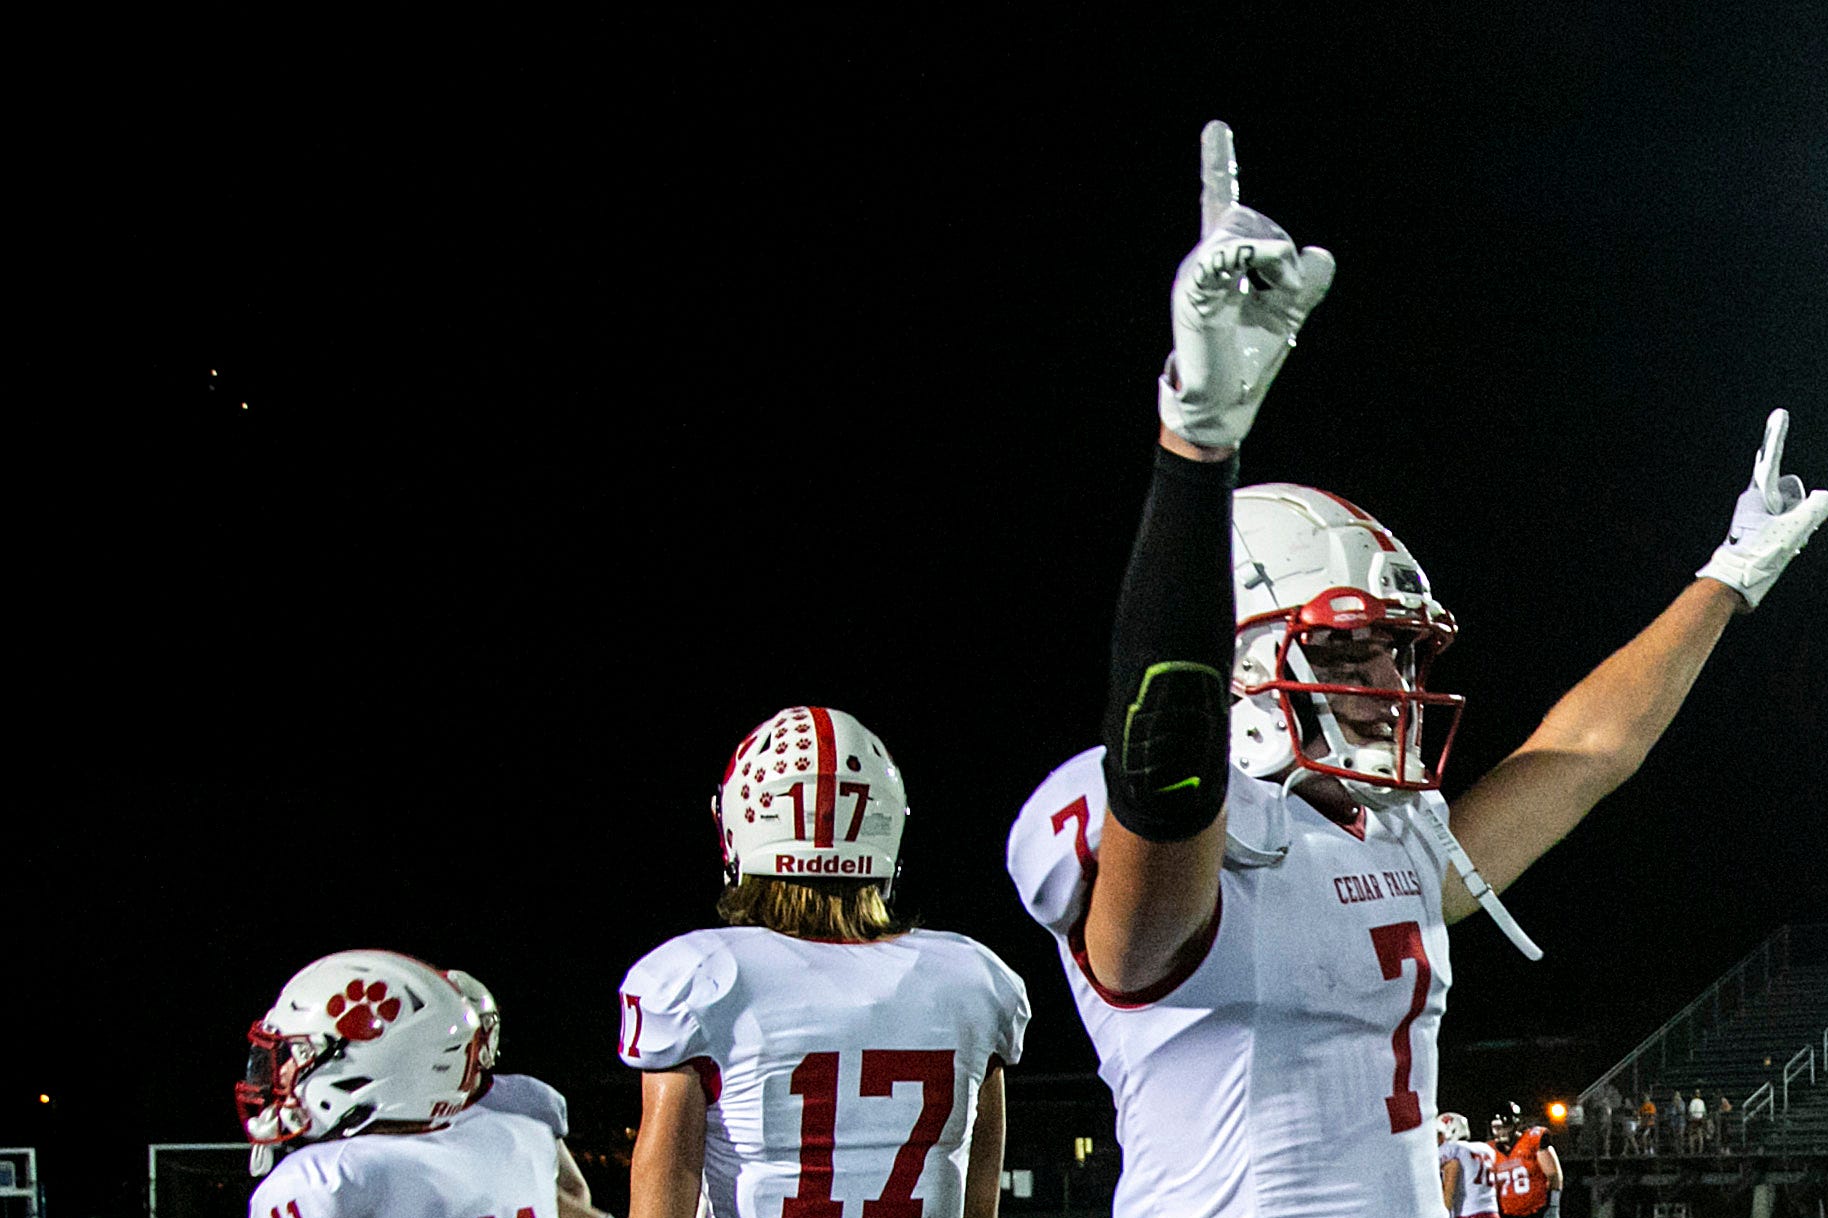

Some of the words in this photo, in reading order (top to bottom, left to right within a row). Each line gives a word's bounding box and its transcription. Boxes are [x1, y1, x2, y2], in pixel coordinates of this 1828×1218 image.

[788, 781, 870, 842] 17
[1050, 794, 1099, 880] 7
[775, 854, 873, 875] Riddell
[1333, 873, 1384, 904] CEDAR
[1382, 869, 1423, 897] FALLS
[1369, 920, 1432, 1134] 7
